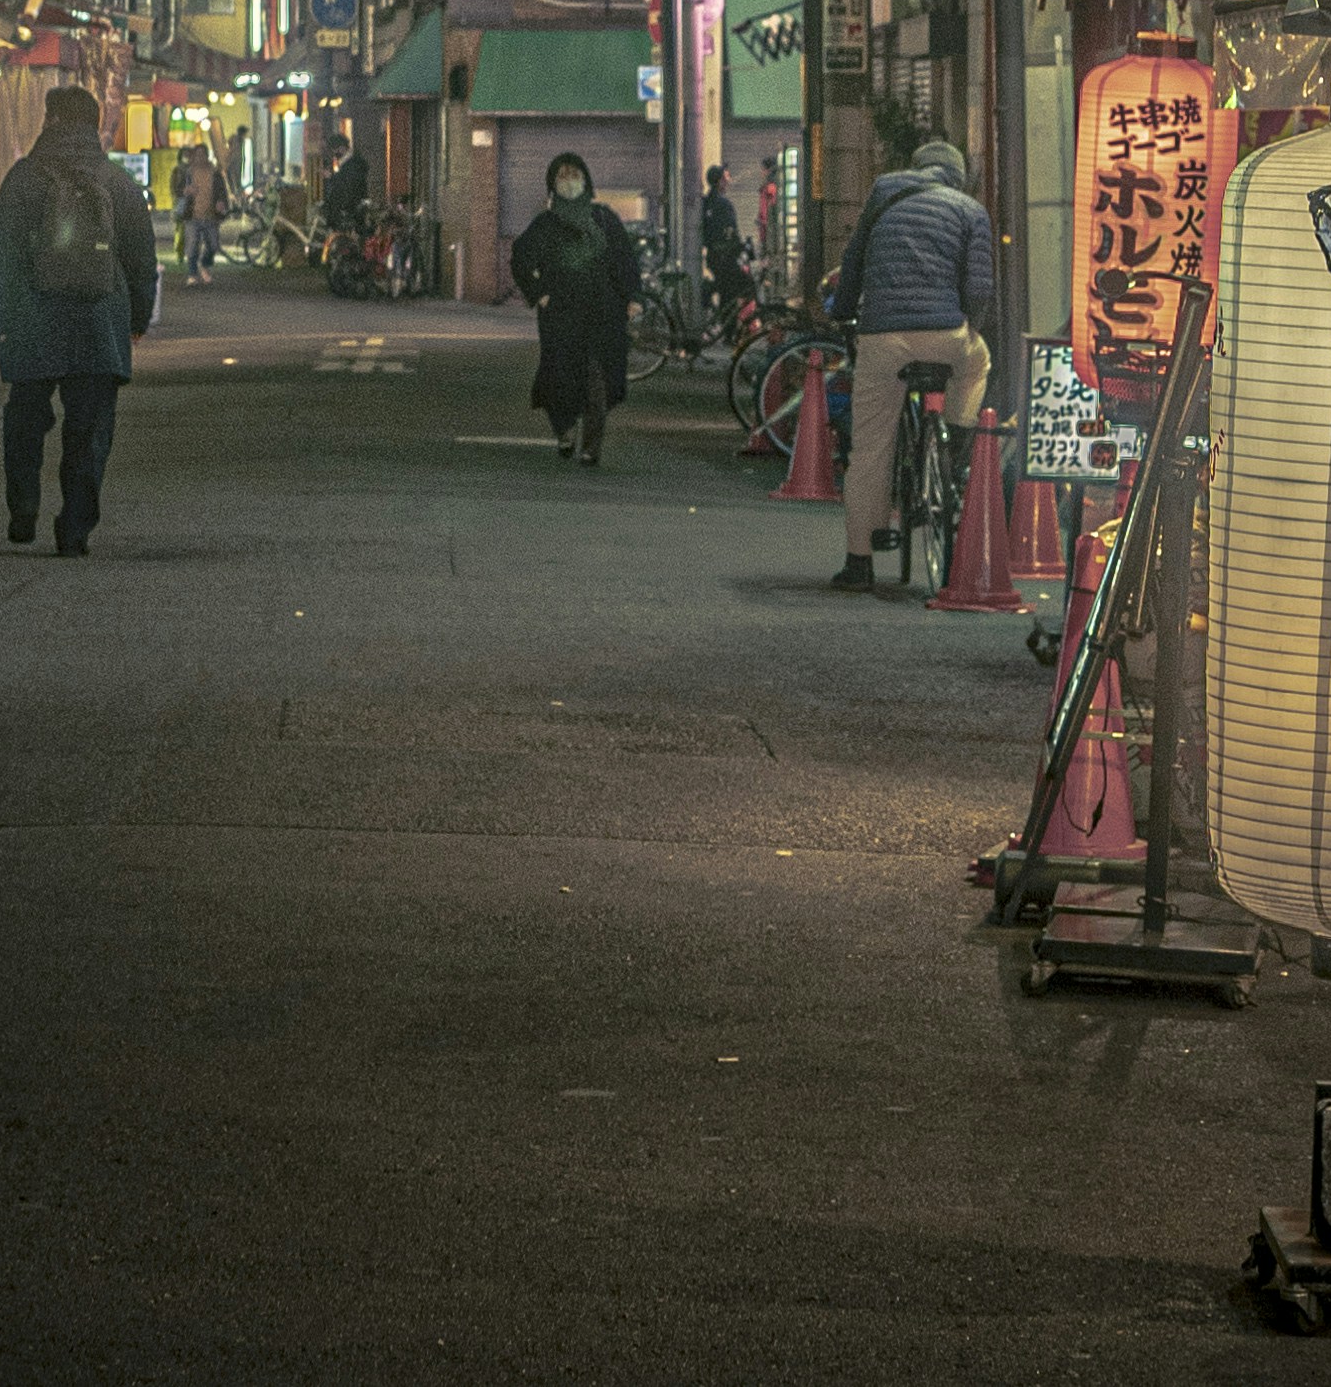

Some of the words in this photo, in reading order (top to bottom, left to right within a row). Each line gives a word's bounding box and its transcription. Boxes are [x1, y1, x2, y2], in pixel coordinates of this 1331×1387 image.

[1110, 95, 1202, 131] 牛串焼
[1107, 128, 1205, 161] ゴーゴー
[1170, 161, 1208, 279] 炭火焼
